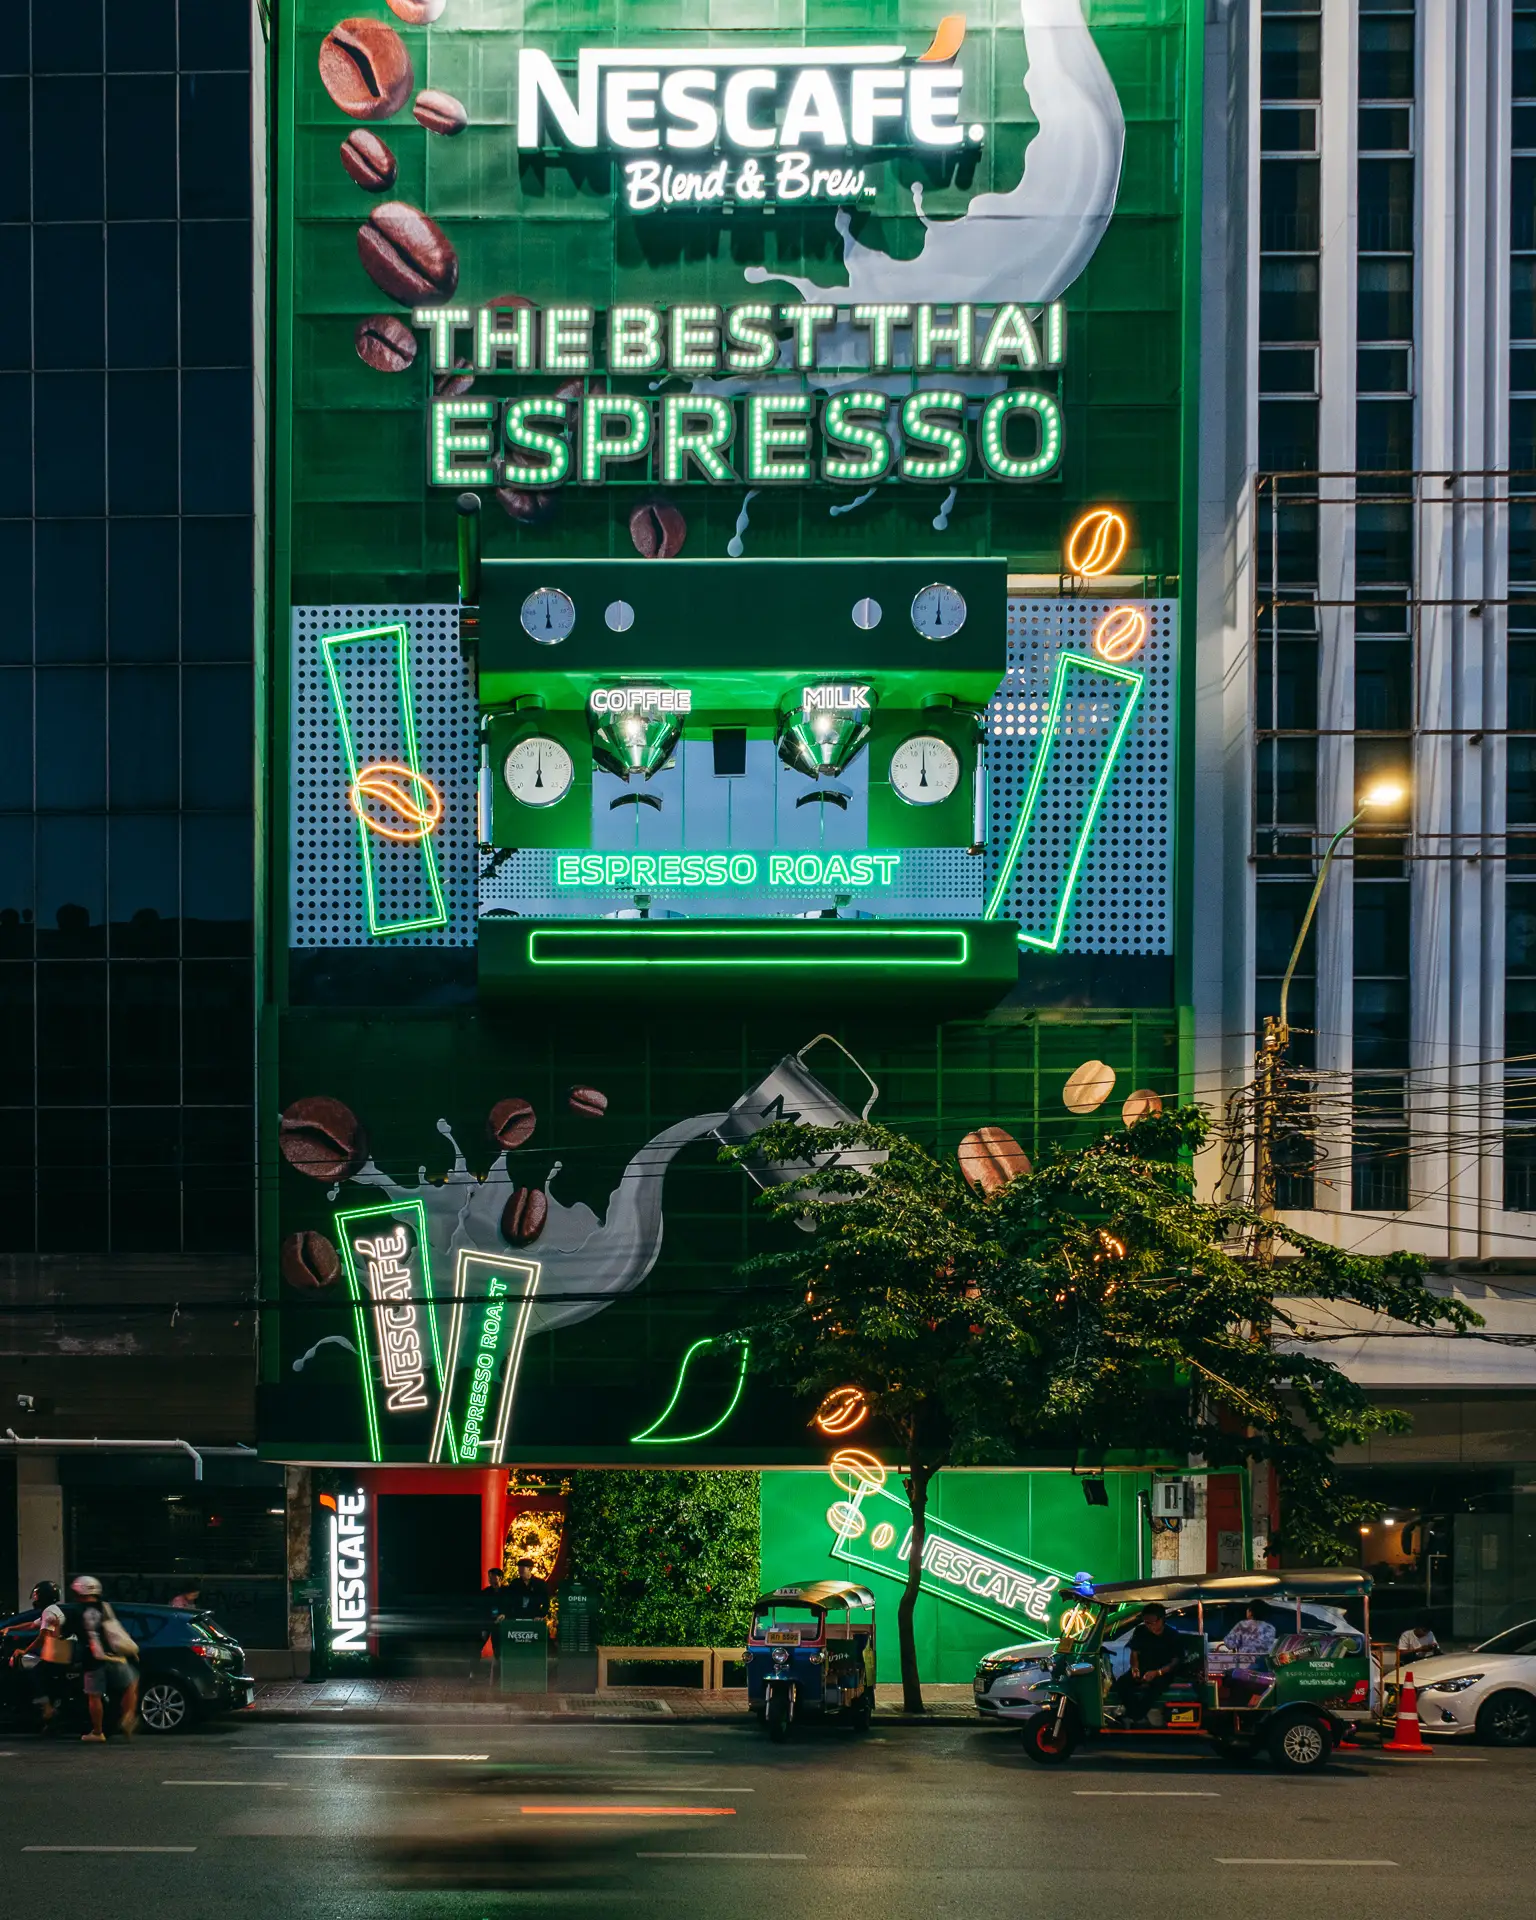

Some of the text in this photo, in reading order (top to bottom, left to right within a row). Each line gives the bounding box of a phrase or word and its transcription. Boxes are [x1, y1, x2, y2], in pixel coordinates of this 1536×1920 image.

[624, 160, 728, 210] Blend
[736, 159, 766, 199] &
[413, 301, 1066, 374] THE BEST THAI
[429, 388, 1064, 489] ESPRESSO
[590, 689, 692, 712] COFFEE
[803, 686, 871, 709] MILK
[557, 854, 900, 886] ESPRESSO ROAST
[461, 1352, 494, 1460] ESPRESSO
